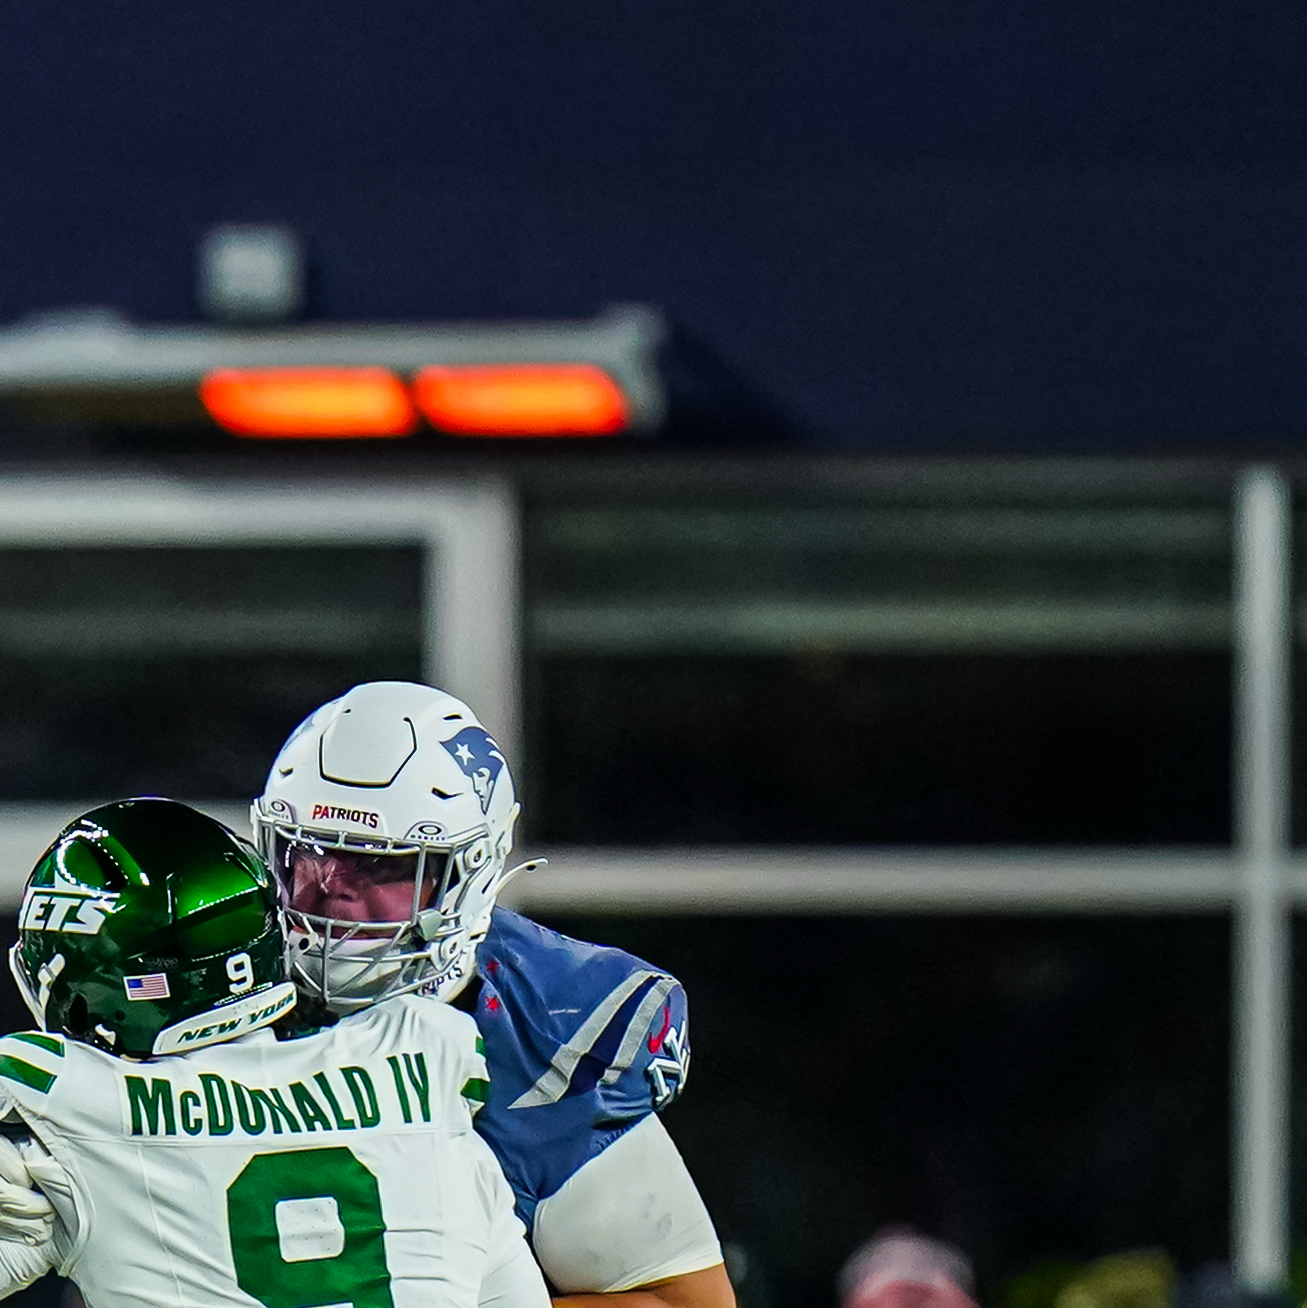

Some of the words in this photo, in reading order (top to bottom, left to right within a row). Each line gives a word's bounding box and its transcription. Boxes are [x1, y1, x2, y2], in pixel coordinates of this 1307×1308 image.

[312, 804, 379, 828] PATRIOTS
[226, 953, 254, 993] 9
[177, 1017, 242, 1044] NEW
[124, 1072, 380, 1136] McDONALD
[386, 1051, 431, 1124] IV
